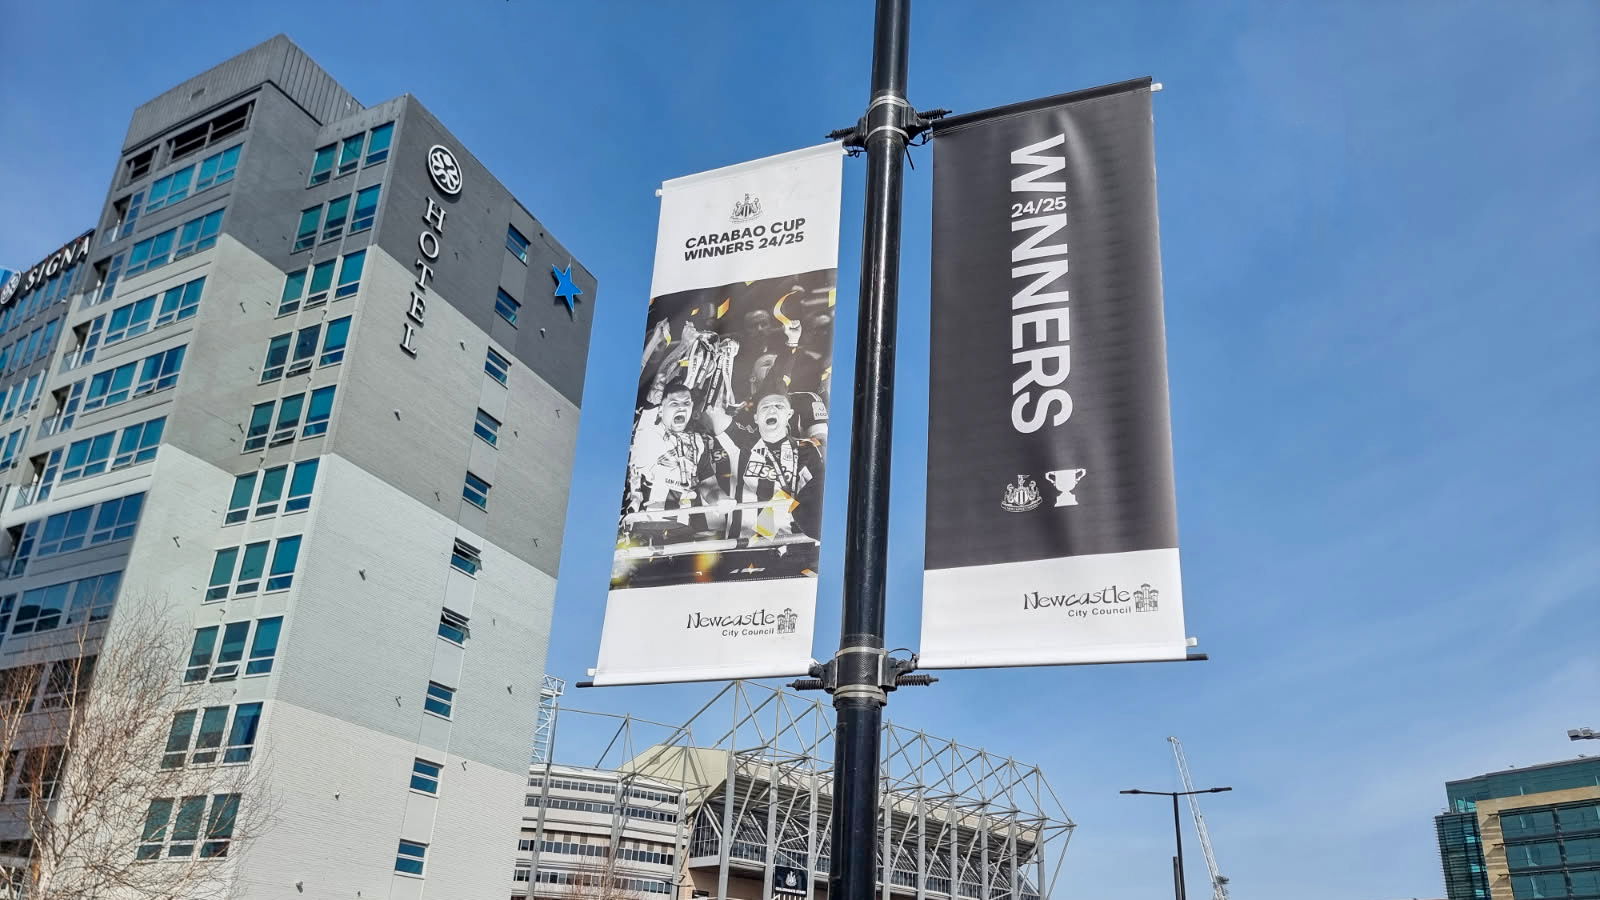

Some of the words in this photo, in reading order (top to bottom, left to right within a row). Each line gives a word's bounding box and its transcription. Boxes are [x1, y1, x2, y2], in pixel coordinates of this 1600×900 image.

[1011, 195, 1067, 218] 24/25
[685, 225, 766, 249] CARABAO
[770, 217, 806, 234] CUP
[684, 240, 754, 262] WINNERS
[758, 231, 804, 250] 24/25
[25, 236, 90, 290] SIGNA
[400, 196, 447, 355] HOTEL
[1023, 585, 1131, 610] Newcastle
[686, 608, 775, 629] Newcastle
[1068, 609, 1088, 618] City
[1091, 606, 1132, 616] Council
[721, 629, 739, 638] City
[741, 627, 775, 636] Council
